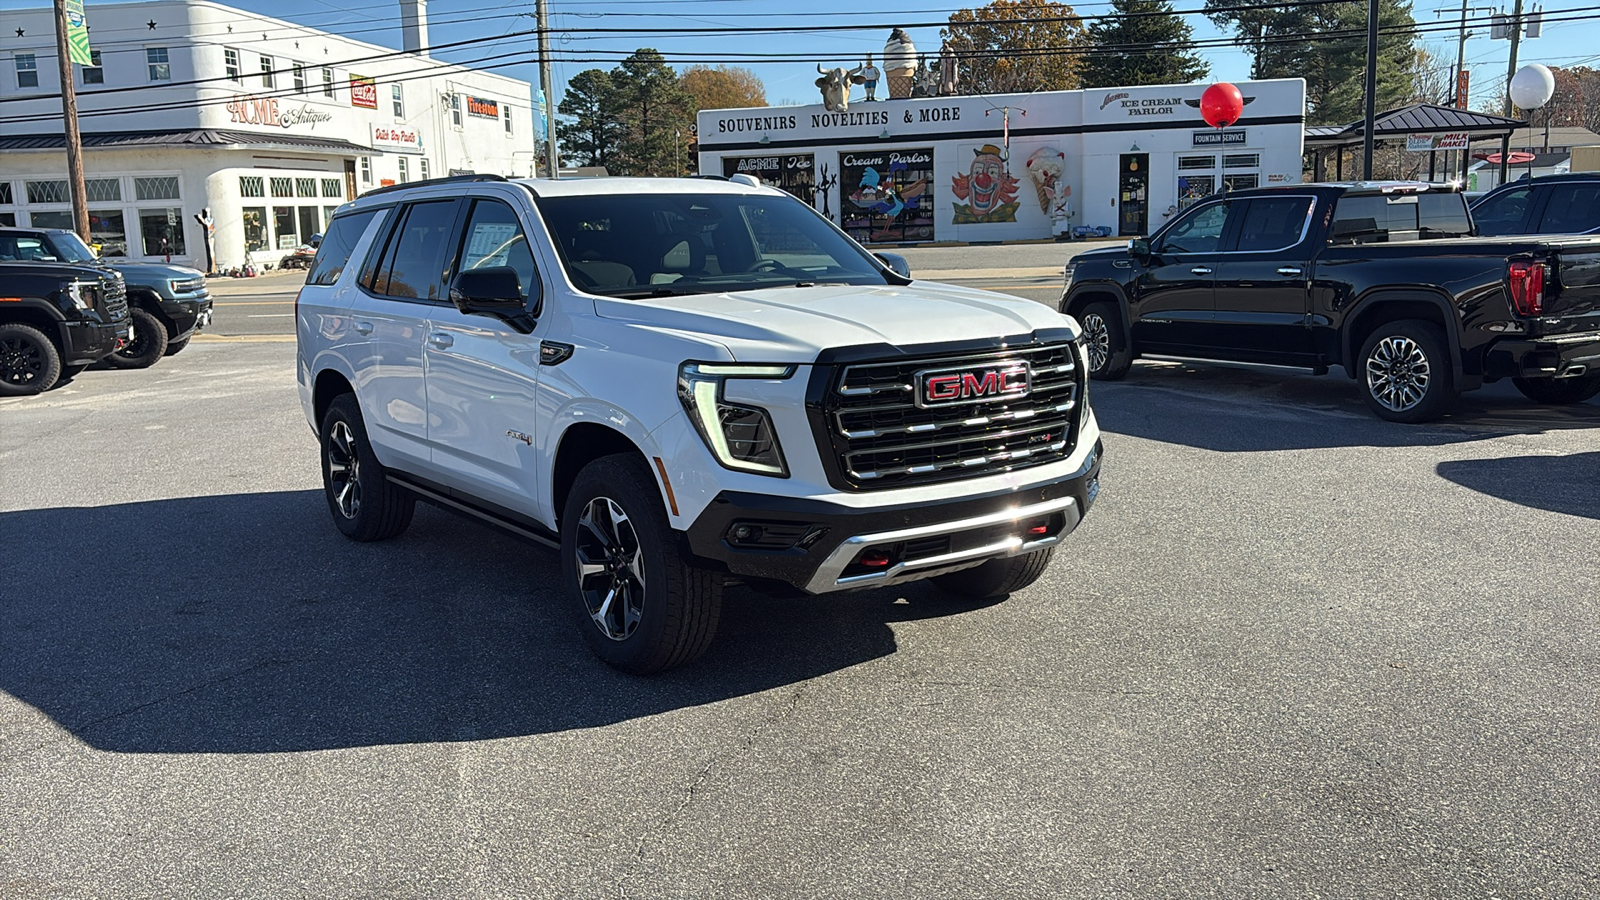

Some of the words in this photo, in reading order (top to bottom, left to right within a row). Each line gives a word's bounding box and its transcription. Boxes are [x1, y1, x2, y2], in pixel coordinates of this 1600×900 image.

[467, 96, 498, 117] Firestone
[1121, 99, 1139, 108] ICE
[1141, 97, 1182, 107] CREAM
[226, 94, 280, 126] ACME
[280, 103, 332, 130] Antiques
[1128, 107, 1173, 116] PARLOR
[718, 116, 796, 133] SOUVENIRS
[811, 111, 889, 128] NOVELTIES
[903, 109, 913, 123] &
[919, 107, 960, 122] MORE
[376, 128, 389, 140] Dutch
[391, 129, 399, 144] Boy
[401, 130, 415, 142] Paints
[1195, 134, 1221, 143] FOUNTAIN
[1223, 133, 1244, 142] SERVICE
[737, 157, 779, 171] ACME
[787, 157, 812, 169] Ice
[843, 154, 883, 166] Cream
[889, 152, 931, 164] Parlor
[927, 367, 1027, 401] GMC
